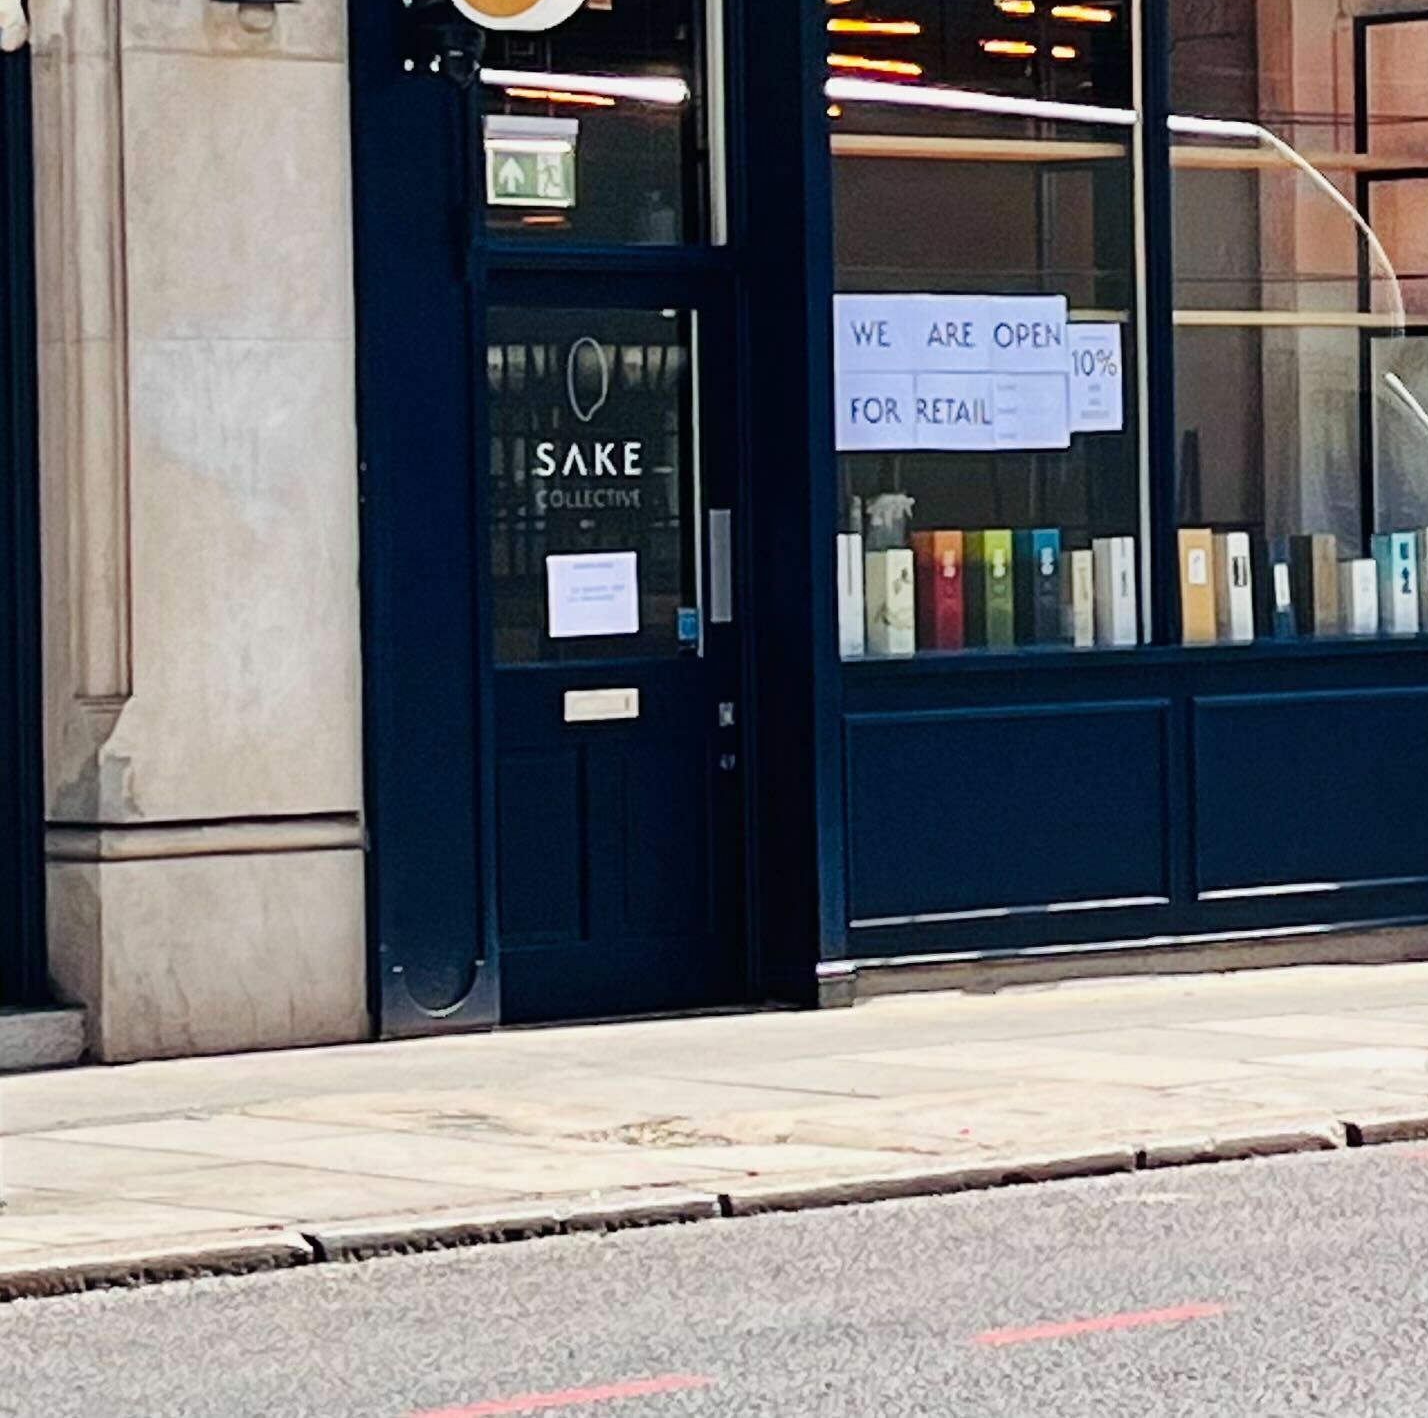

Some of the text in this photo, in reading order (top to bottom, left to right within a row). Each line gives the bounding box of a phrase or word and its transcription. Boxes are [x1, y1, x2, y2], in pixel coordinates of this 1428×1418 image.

[850, 320, 1062, 349] WE ARE OPEN
[1071, 348, 1118, 378] 10%
[850, 397, 902, 425] FOR
[915, 397, 994, 426] RETAIL
[536, 441, 643, 477] SAKE
[536, 488, 642, 509] COLLECTIVE
